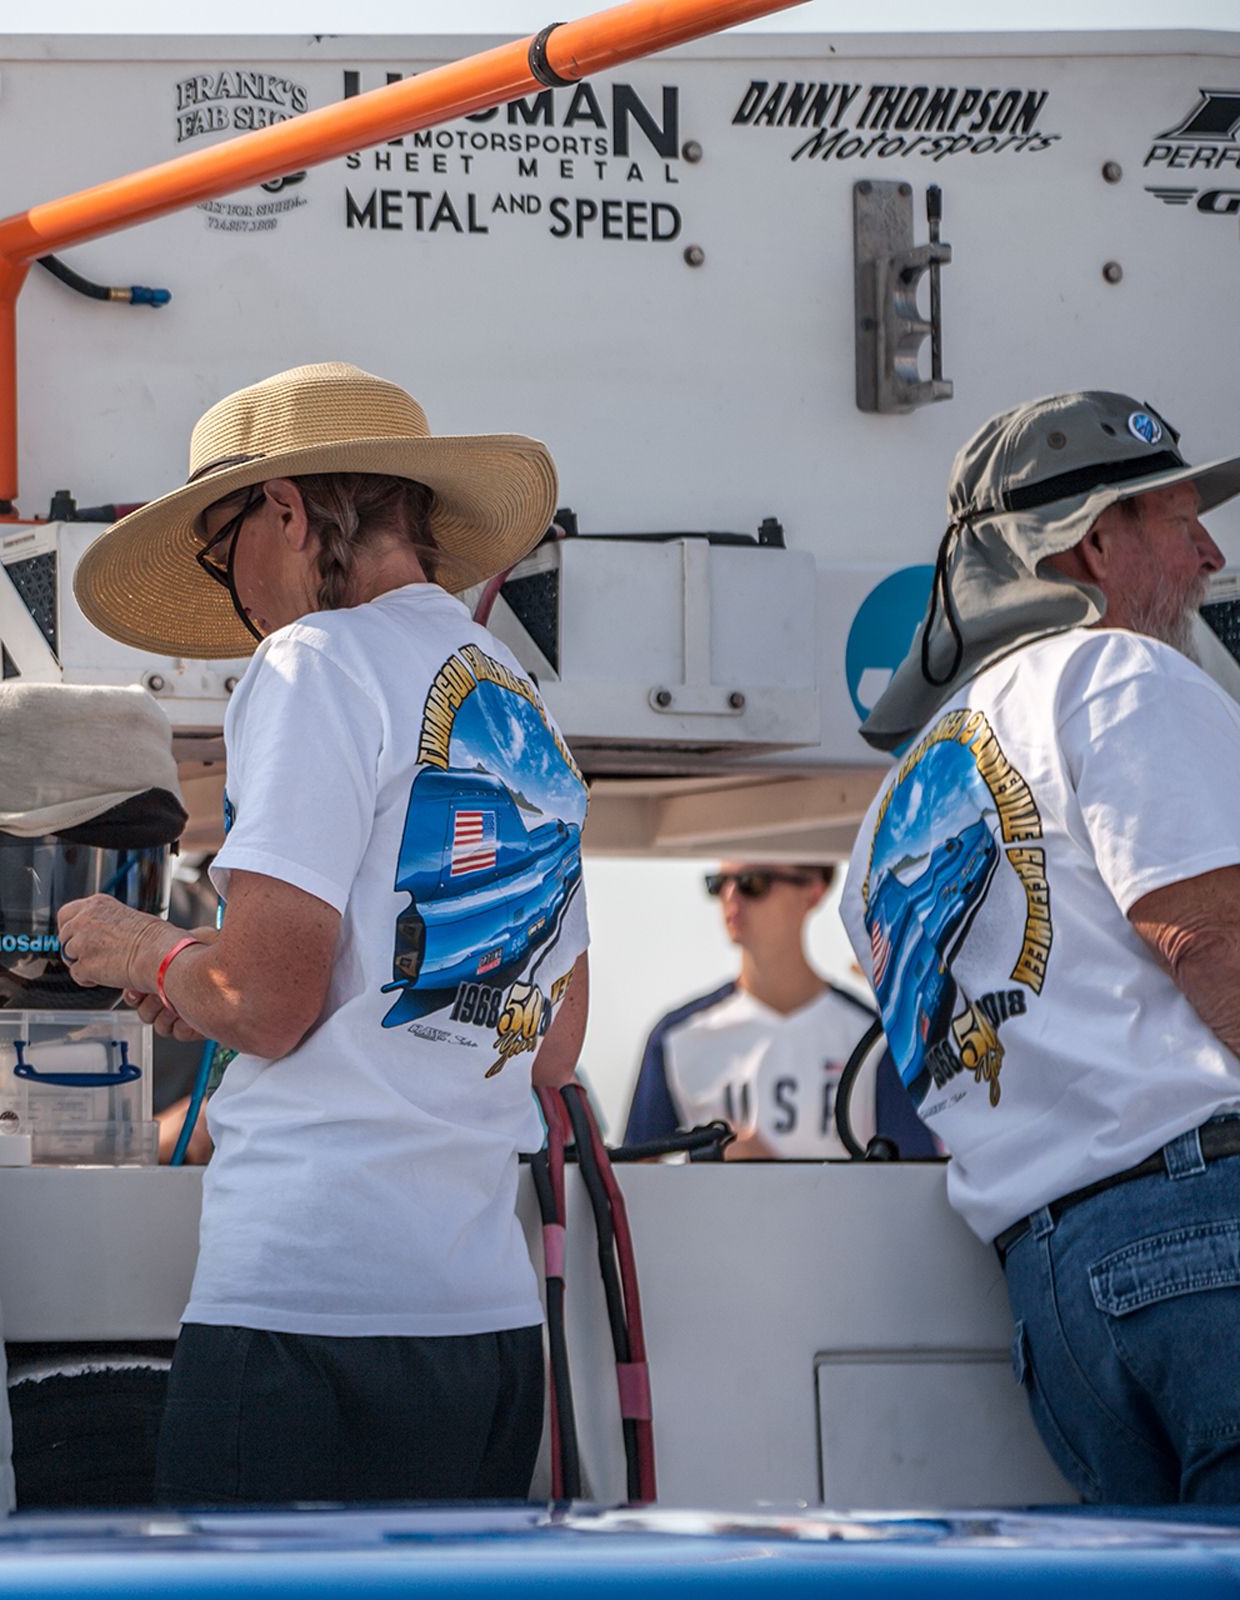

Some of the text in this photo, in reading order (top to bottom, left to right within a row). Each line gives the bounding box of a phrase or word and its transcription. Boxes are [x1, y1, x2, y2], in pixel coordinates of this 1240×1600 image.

[176, 71, 308, 114] FRANK'S
[731, 80, 1050, 136] DANNY THOMPSON
[176, 105, 230, 143] FAB
[413, 130, 608, 155] MOTORSPORTS
[791, 128, 1063, 162] Motorsports
[345, 152, 679, 184] SHEET METAL
[1143, 145, 1240, 169] PERF
[344, 186, 683, 243] METAL AND SPEED
[415, 654, 477, 772] THOMPSON
[449, 980, 504, 1029] 1968
[496, 981, 544, 1041] 50
